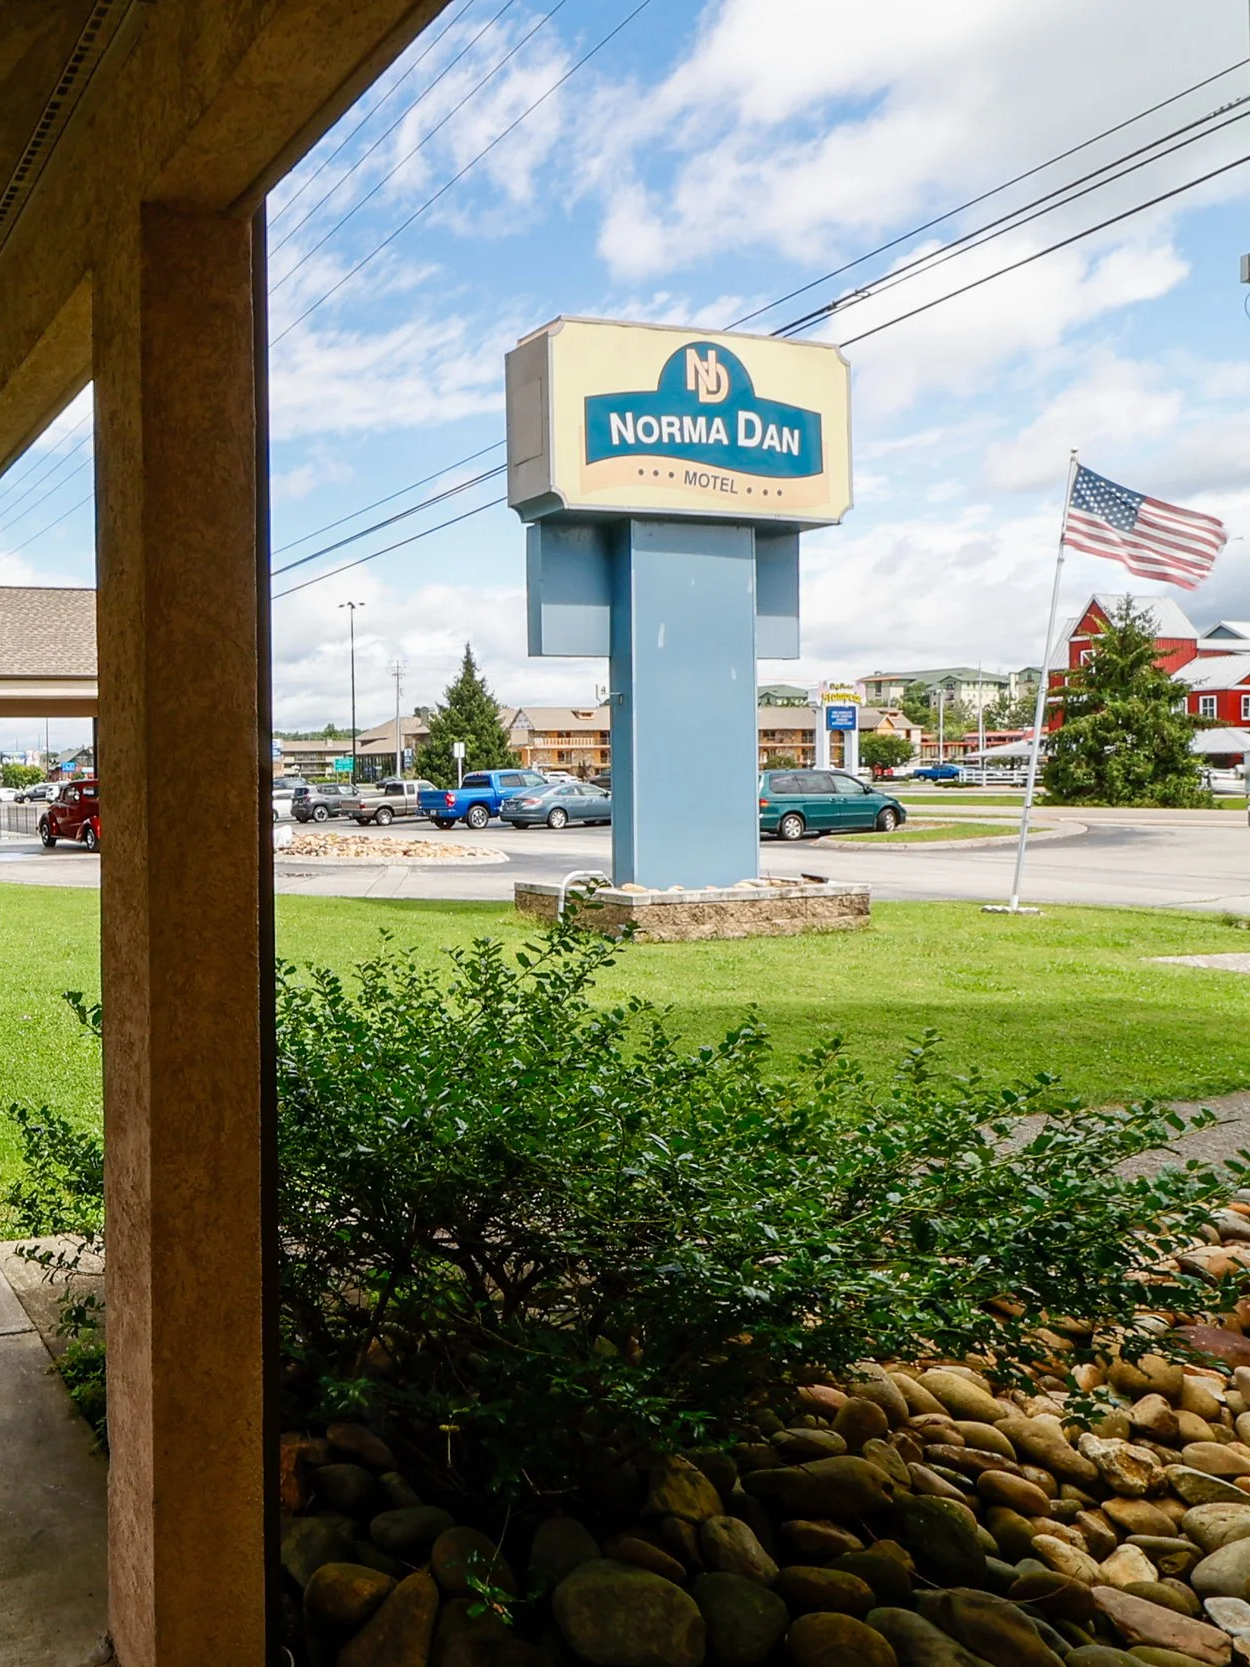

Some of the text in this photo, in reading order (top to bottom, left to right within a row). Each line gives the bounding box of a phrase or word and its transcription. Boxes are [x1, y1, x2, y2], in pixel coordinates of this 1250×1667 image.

[609, 410, 800, 456] NORMA DAN
[684, 470, 738, 494] MOTEL
